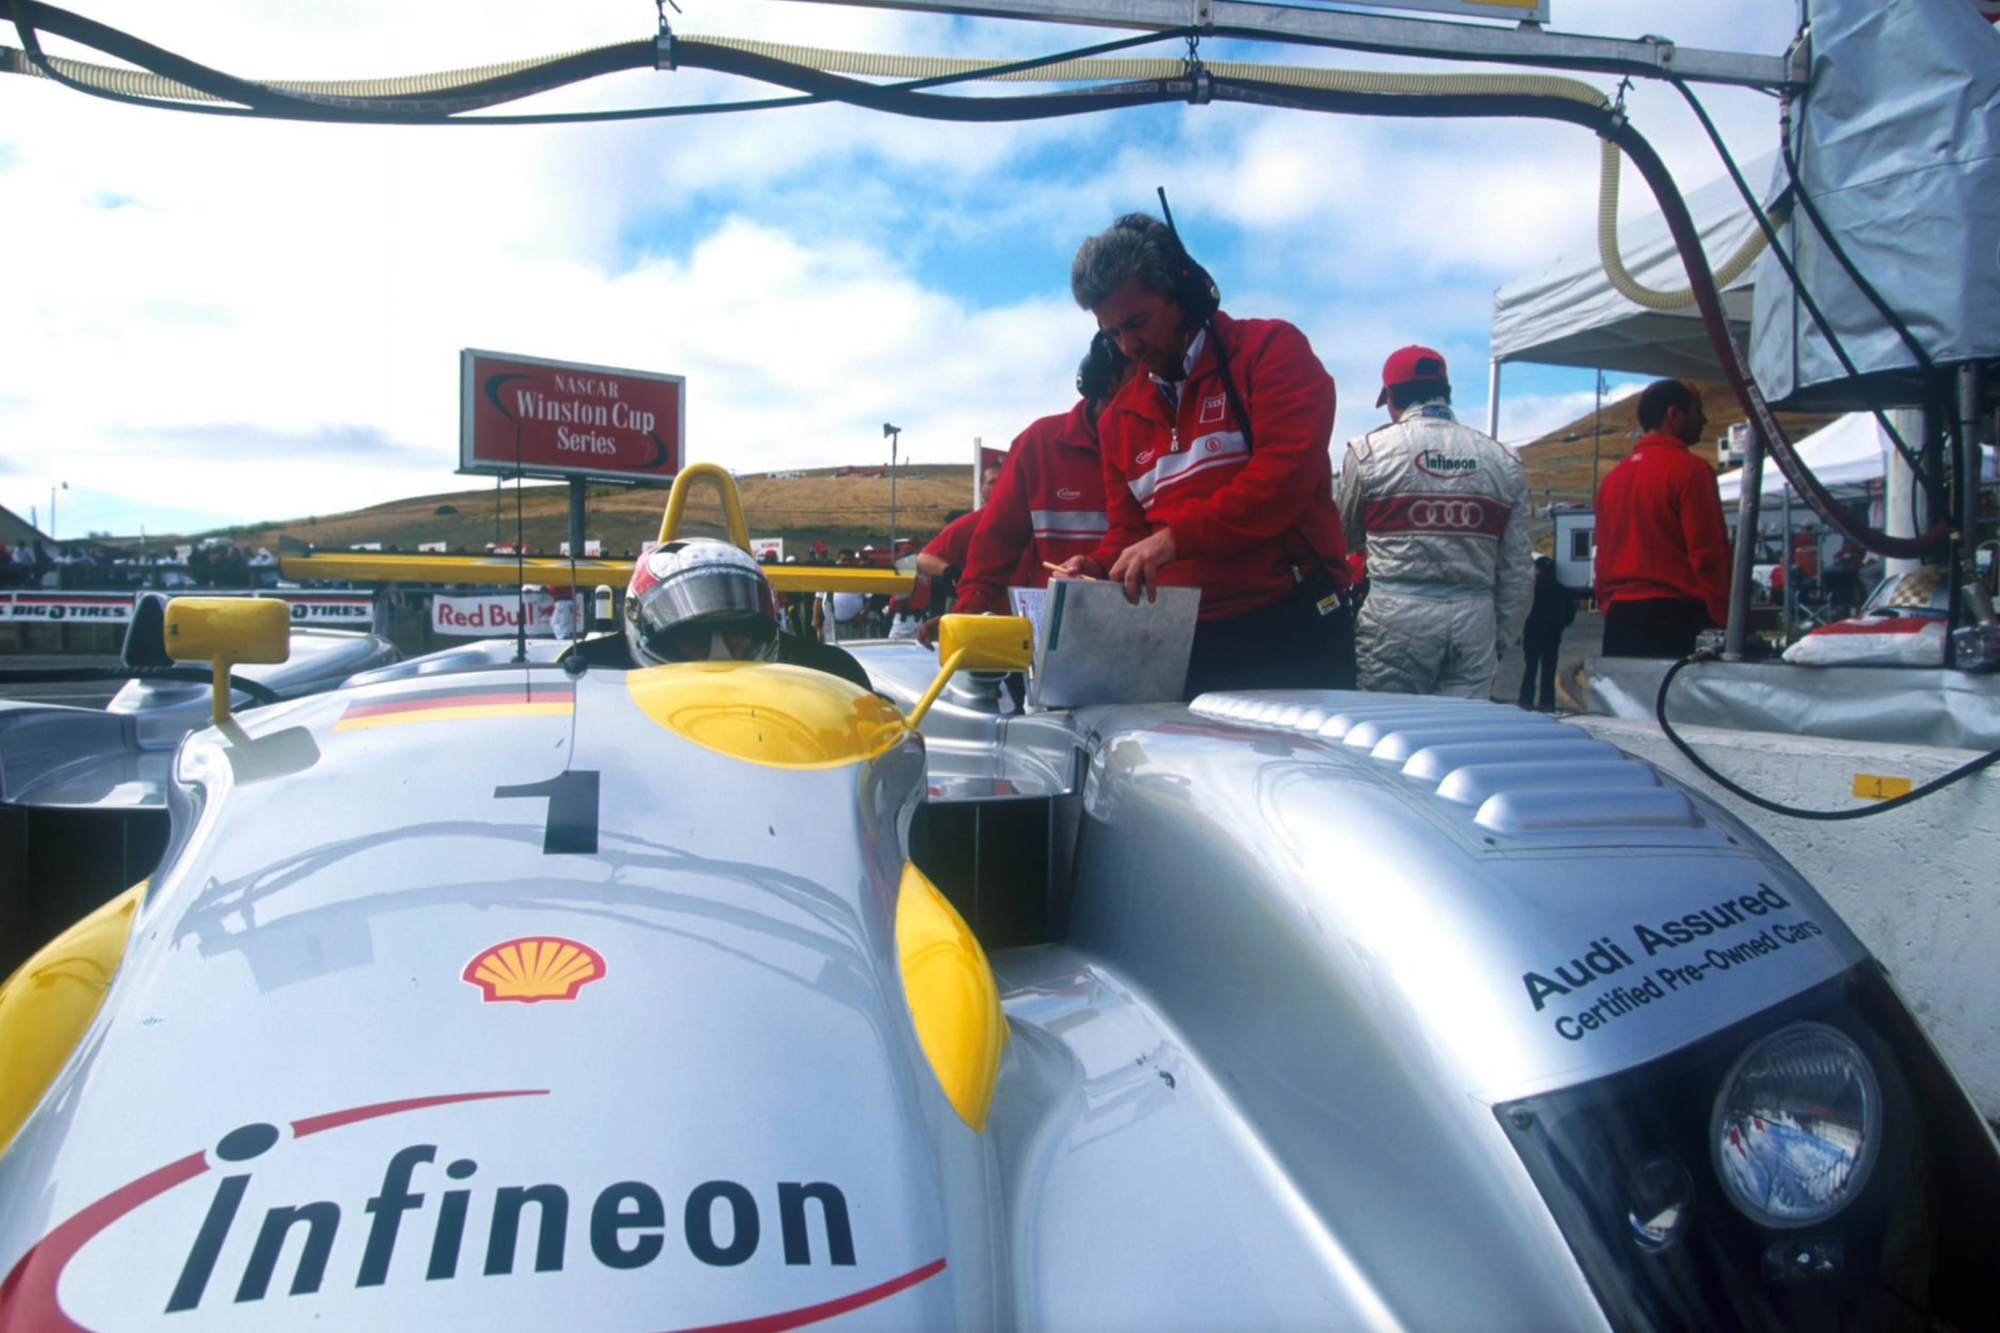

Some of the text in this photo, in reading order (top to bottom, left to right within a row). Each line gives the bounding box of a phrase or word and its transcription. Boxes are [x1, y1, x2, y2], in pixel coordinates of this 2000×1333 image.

[554, 375, 619, 398] NASCAR
[516, 390, 655, 434] Winston Cup
[557, 426, 616, 454] Series
[12, 605, 48, 616] BIG
[68, 606, 126, 617] TIRES
[309, 605, 366, 616] TIRES
[438, 602, 534, 627] Red Bull
[493, 770, 600, 854] 1
[1522, 883, 1790, 1012] Audi Assured
[1555, 919, 1823, 1041] Certified Pre-Owned Cars
